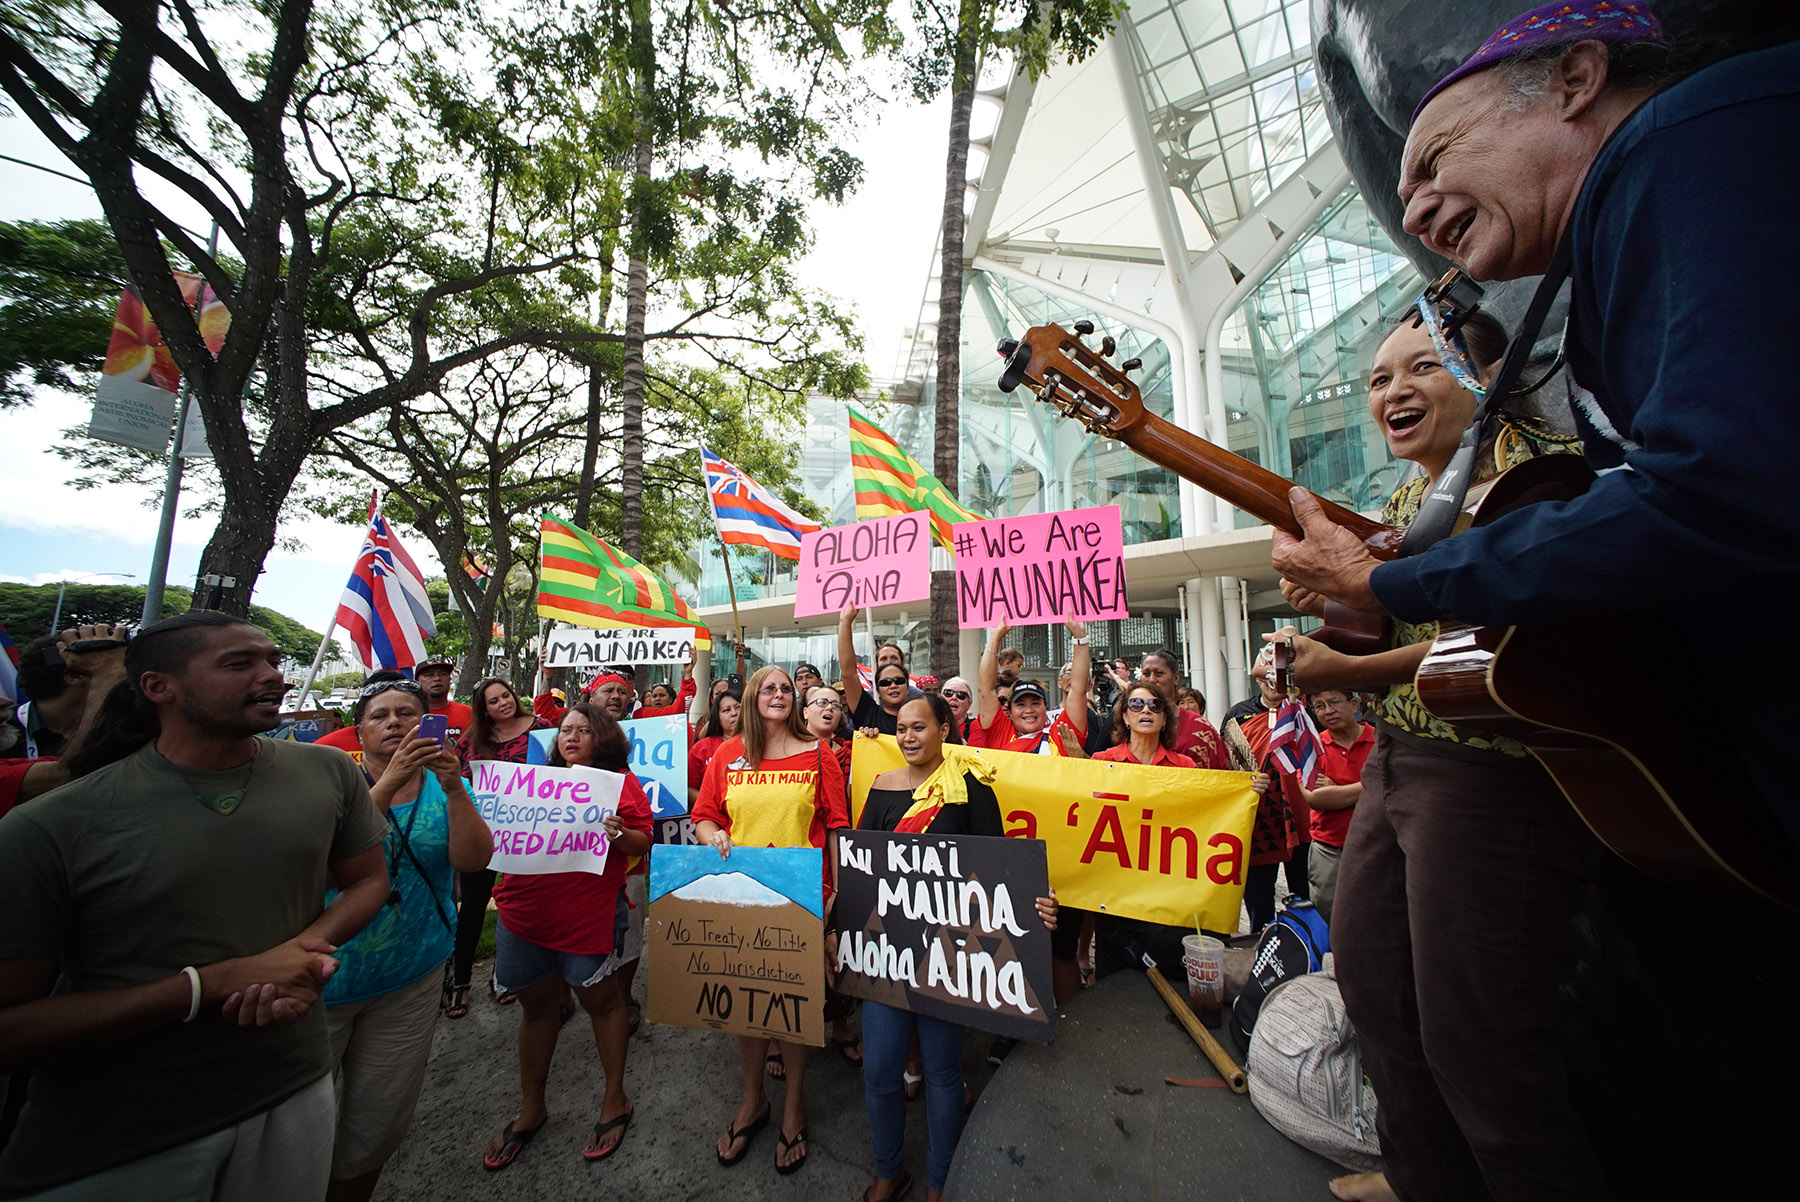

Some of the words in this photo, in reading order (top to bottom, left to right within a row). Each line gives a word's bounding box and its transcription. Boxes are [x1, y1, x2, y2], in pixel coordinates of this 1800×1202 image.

[98, 400, 170, 421] INTERNATIONAL
[100, 407, 168, 428] ASTRONOMICAL
[121, 399, 154, 411] ALOHA
[119, 418, 150, 431] UNION
[814, 517, 918, 568] ALOHA
[1046, 515, 1102, 553] Are
[960, 550, 1129, 624] MAUNAKEA
[594, 629, 623, 640] WE
[627, 629, 660, 639] ARE
[478, 763, 501, 793] No
[503, 766, 592, 804] More
[493, 829, 545, 856] CRED
[546, 829, 608, 857] LANDS
[666, 918, 691, 943] No
[753, 926, 772, 949] No
[770, 926, 807, 951] Title
[687, 951, 711, 974] No
[721, 951, 803, 982] Jurisdiction
[837, 930, 921, 989] Aloha
[1188, 965, 1219, 982] GULP
[696, 982, 733, 1020] NO
[739, 986, 809, 1033] TMT
